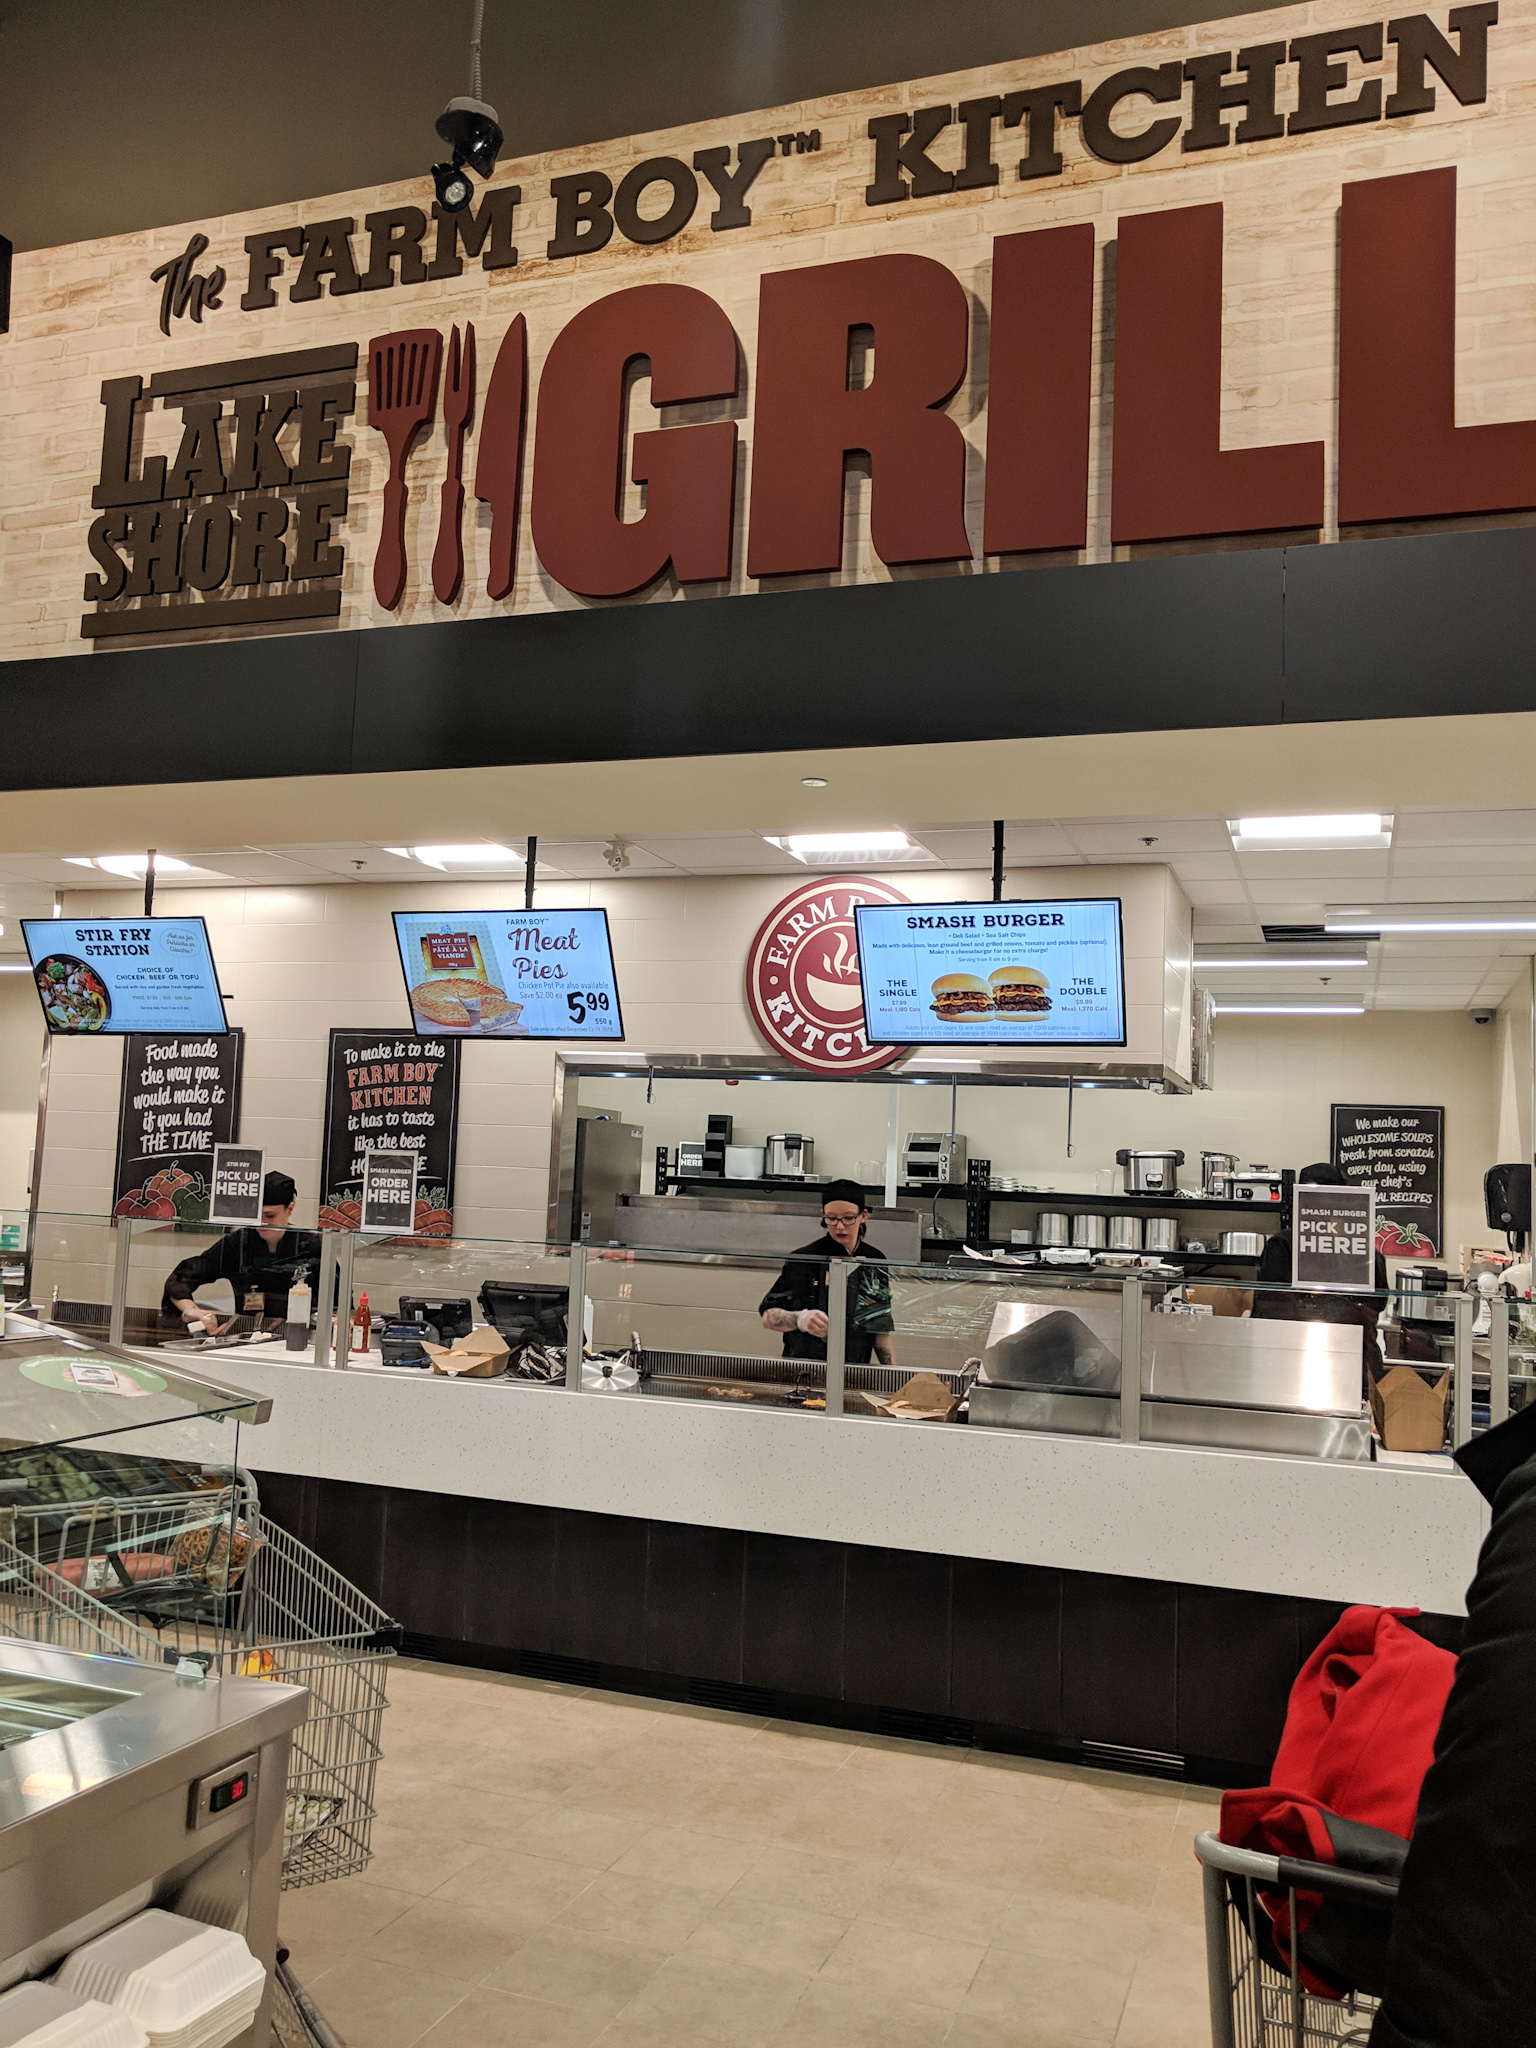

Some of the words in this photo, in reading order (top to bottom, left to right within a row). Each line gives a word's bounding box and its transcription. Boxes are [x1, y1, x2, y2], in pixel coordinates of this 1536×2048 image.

[150, 233, 227, 336] The
[241, 186, 522, 311] FARM
[866, 1, 1499, 206] KITCHEN
[530, 166, 1536, 599] GRILL
[92, 375, 357, 509] LAKE
[84, 489, 349, 602] SHORE
[906, 915, 976, 929] SMASH
[983, 913, 1065, 927] BURGER
[75, 929, 114, 942] STIR
[119, 928, 152, 941] FRY
[507, 927, 581, 952] Meat
[766, 896, 839, 968] FARM
[85, 944, 150, 956] STATION
[432, 945, 450, 953] PÂTÉ
[1058, 939, 1079, 947] pickles
[512, 957, 569, 979] Pies
[518, 981, 542, 989] Chicken
[580, 981, 609, 989] available
[886, 979, 908, 987] THE
[1071, 977, 1094, 985] THE
[520, 991, 534, 999] Save
[535, 991, 554, 999] $2.00
[879, 989, 918, 997] SINGLE
[1060, 987, 1108, 995] DOUBLE
[766, 991, 875, 1058] KITC
[145, 1039, 180, 1064] Food
[180, 1037, 219, 1059] made
[344, 1049, 359, 1064] To
[360, 1043, 392, 1061] make
[393, 1041, 406, 1058] it
[407, 1043, 421, 1057] to
[423, 1040, 446, 1058] the
[140, 1066, 165, 1086] the
[166, 1065, 192, 1085] way
[194, 1064, 221, 1085] you
[347, 1064, 400, 1089] FARM
[133, 1086, 172, 1110] would
[173, 1084, 210, 1105] make
[211, 1084, 226, 1104] it
[350, 1085, 433, 1111] KITCHEN
[142, 1110, 155, 1132] if
[156, 1113, 182, 1132] you
[184, 1107, 213, 1127] had
[347, 1114, 360, 1131] it
[361, 1113, 384, 1128] has
[385, 1112, 400, 1126] to
[401, 1110, 435, 1126] taste
[1355, 1118, 1372, 1130] We
[1372, 1116, 1400, 1129] make
[1400, 1117, 1420, 1128] our
[139, 1131, 170, 1154] THE
[170, 1130, 214, 1151] TIME
[354, 1134, 376, 1152] like
[376, 1132, 398, 1149] the
[399, 1131, 426, 1149] best
[1341, 1132, 1400, 1147] WHOLESOME
[1401, 1132, 1434, 1144] SOUPS
[1339, 1149, 1367, 1163] fresh
[1367, 1147, 1394, 1161] from
[1394, 1146, 1436, 1159] scratch
[681, 1159, 703, 1167] HERE
[1347, 1164, 1373, 1176] every
[1374, 1161, 1397, 1174] day,
[1398, 1163, 1427, 1175] using
[216, 1170, 241, 1181] PICK
[244, 1171, 260, 1182] UP
[371, 1177, 409, 1188] ORDER
[1361, 1179, 1380, 1188] our
[215, 1182, 259, 1197] HERE
[367, 1189, 411, 1204] HERE
[1390, 1191, 1434, 1204] RECIPES
[1301, 1208, 1331, 1216] SMASH
[1332, 1209, 1367, 1218] BURGER
[1300, 1220, 1338, 1234] PICK
[1343, 1222, 1368, 1235] UP
[1300, 1235, 1367, 1256] HERE
